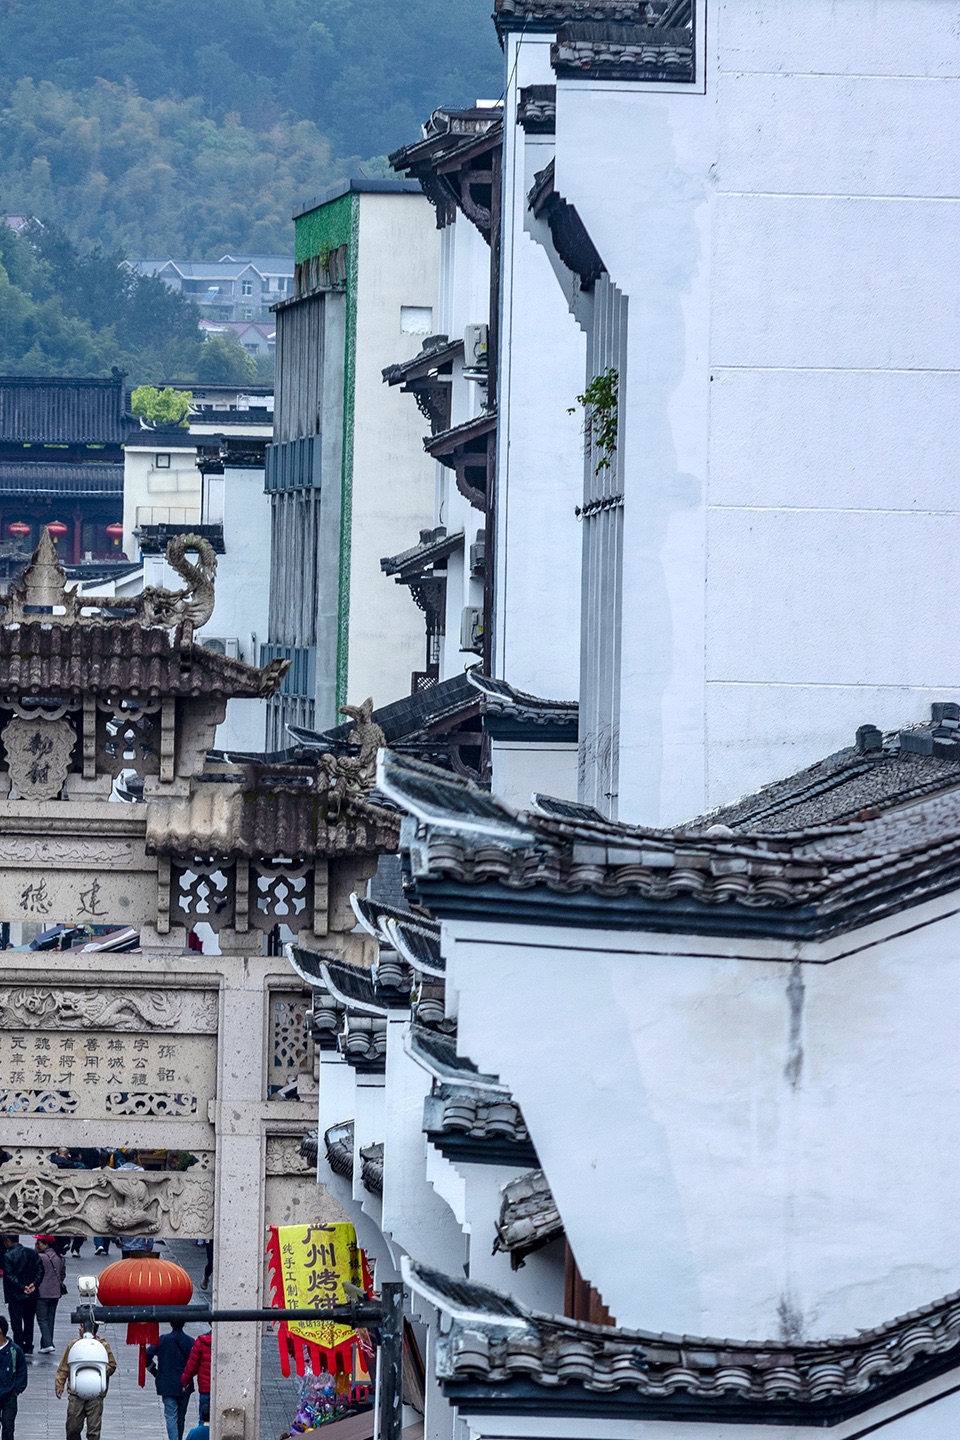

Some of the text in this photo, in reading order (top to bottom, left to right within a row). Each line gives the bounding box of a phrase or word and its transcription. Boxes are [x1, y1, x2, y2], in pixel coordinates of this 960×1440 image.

[84, 1037, 100, 1084] 善用兵
[107, 1039, 125, 1084] 梅城人
